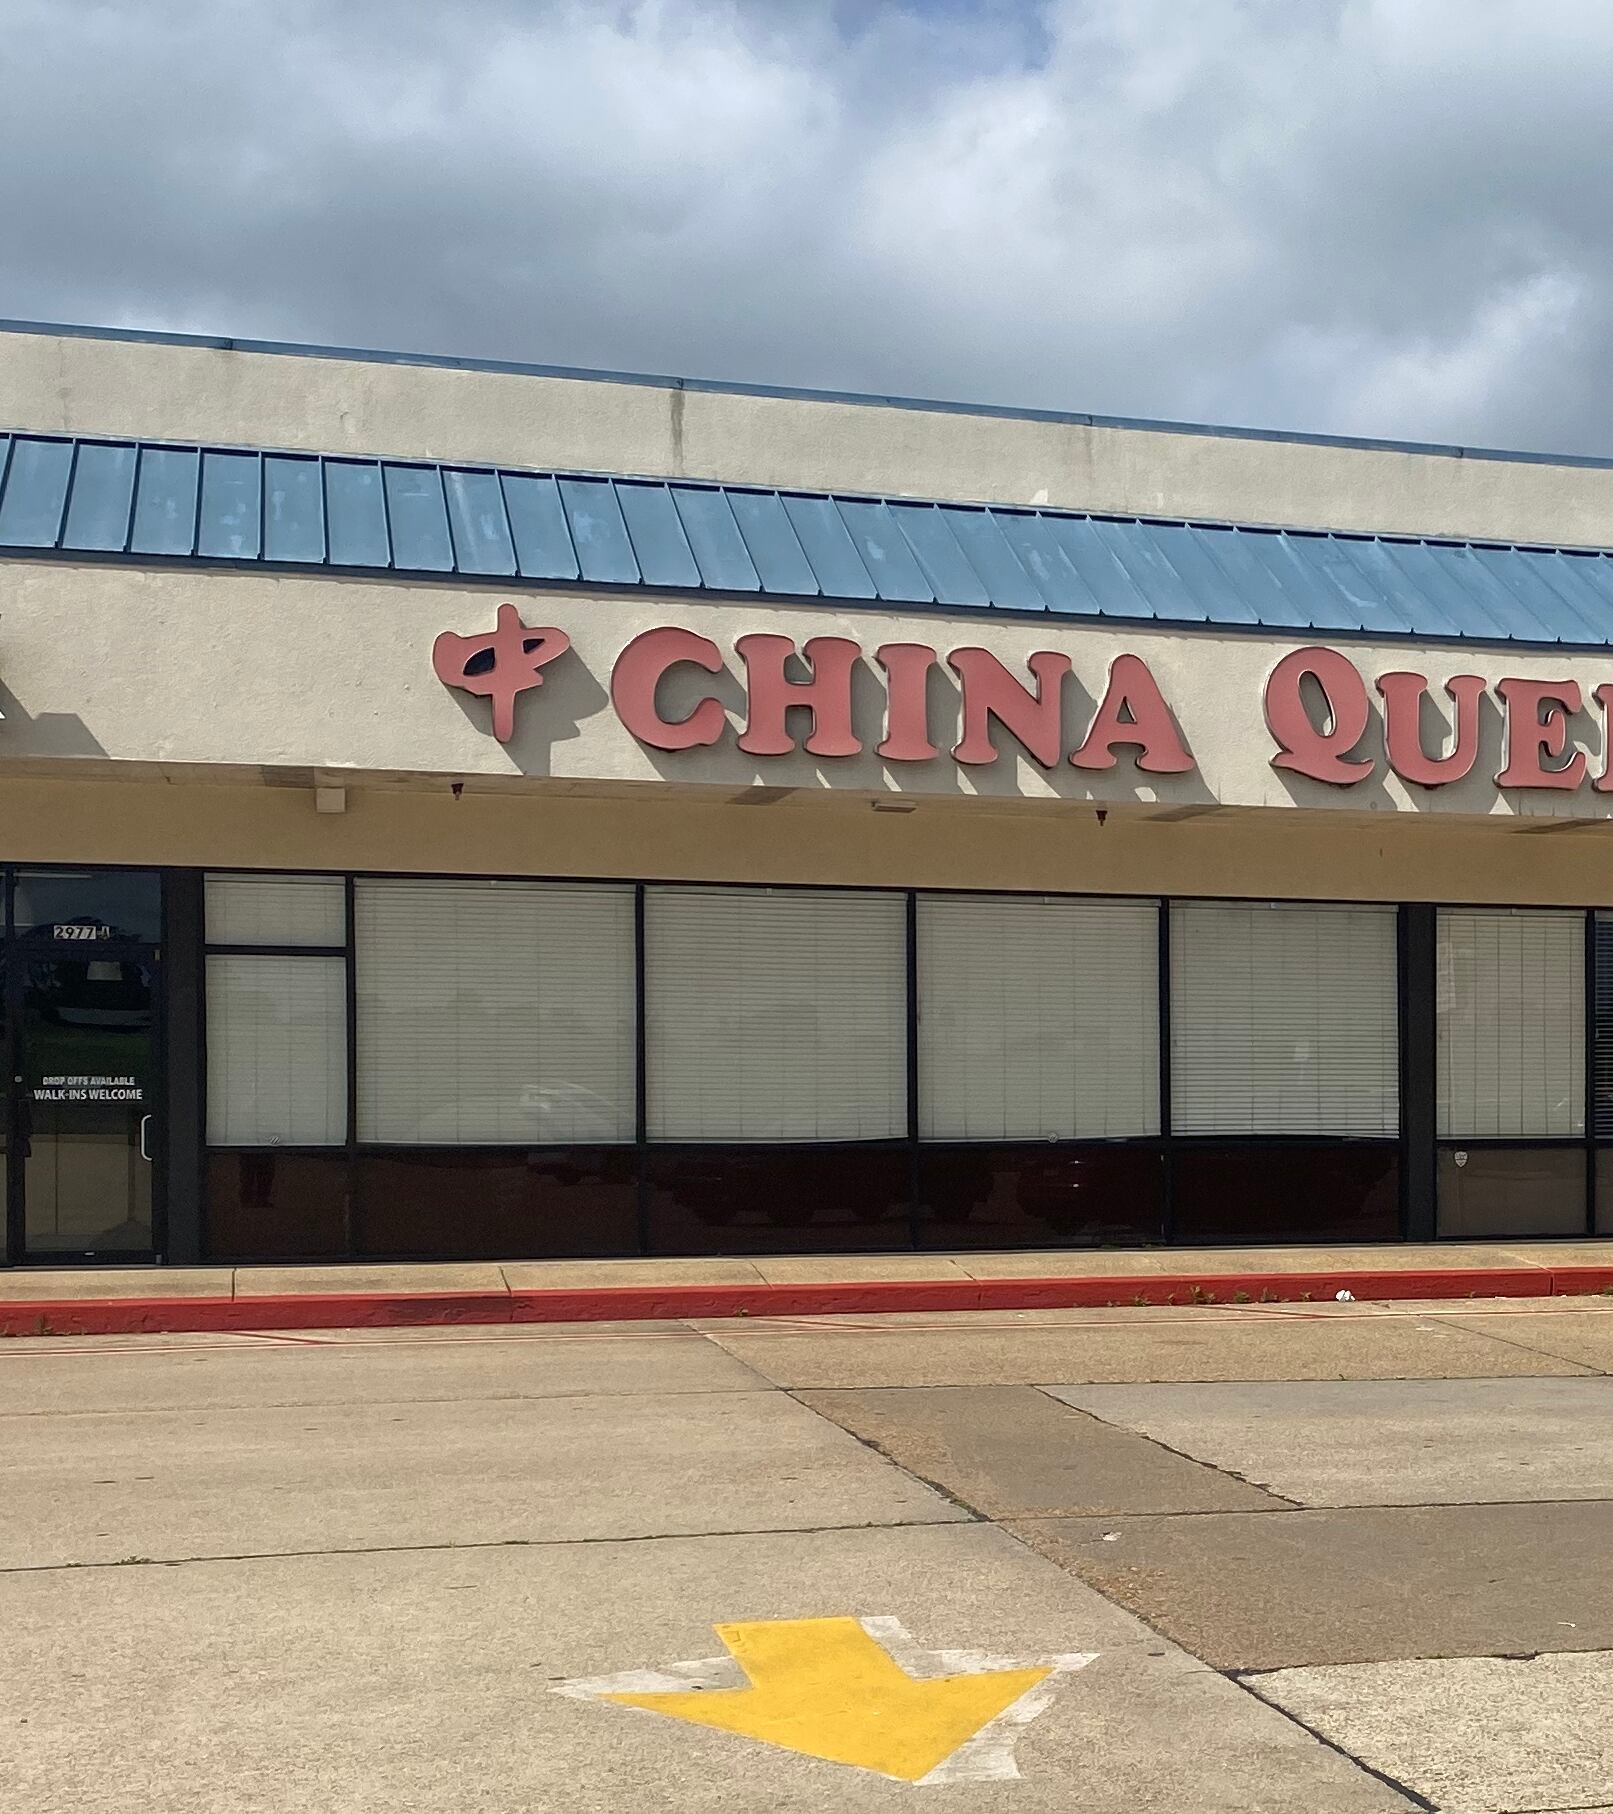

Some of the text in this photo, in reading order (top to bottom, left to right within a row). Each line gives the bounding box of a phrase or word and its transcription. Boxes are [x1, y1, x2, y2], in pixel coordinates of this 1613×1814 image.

[432, 602, 571, 744] 中
[610, 626, 1196, 774] CHINA
[33, 1089, 143, 1100] WALK-INS WELCOME
[43, 1076, 136, 1086] DROP OFFS AVAILABLE
